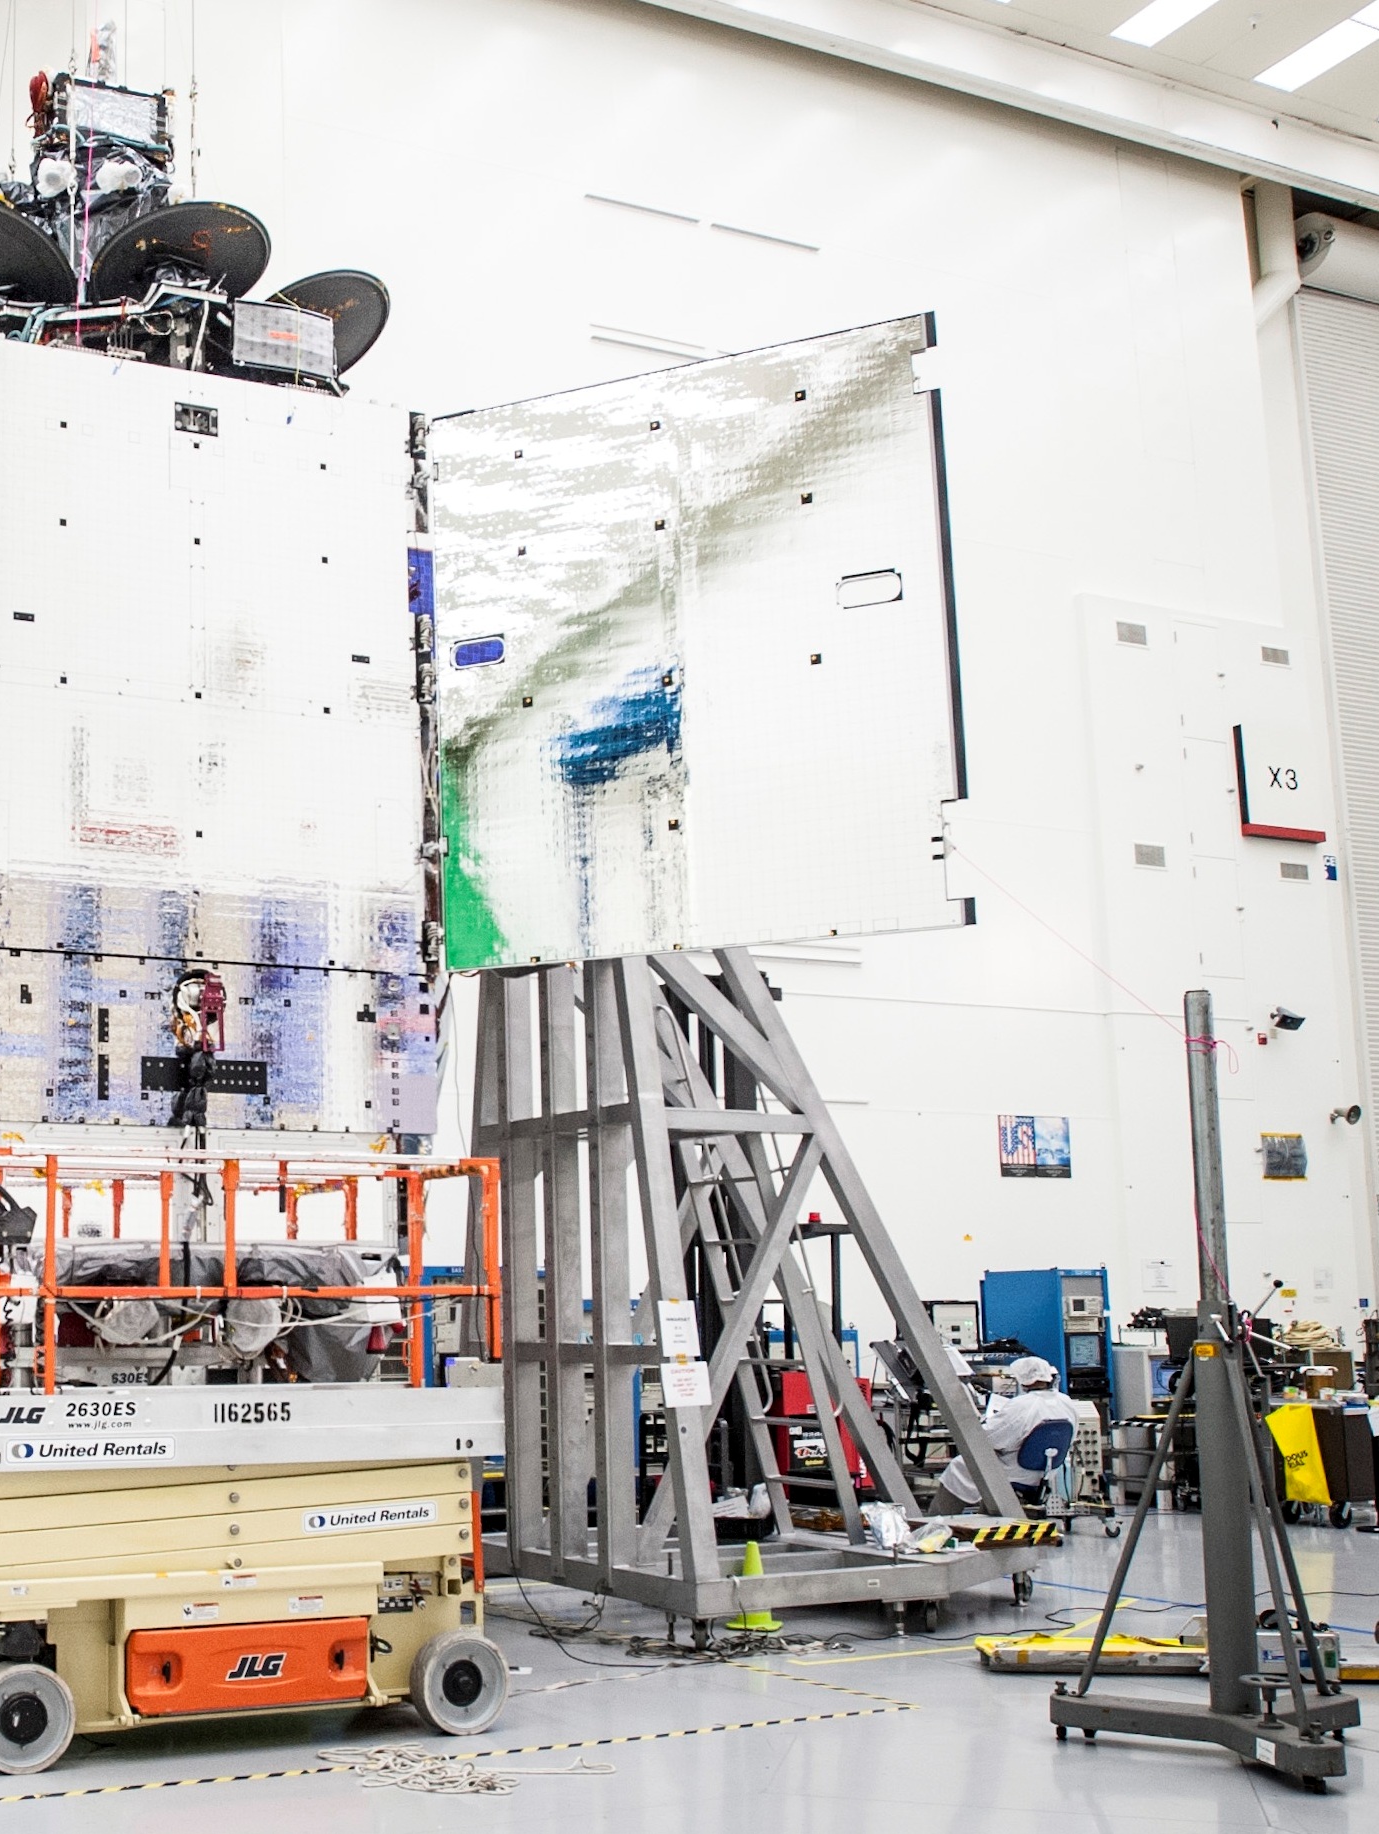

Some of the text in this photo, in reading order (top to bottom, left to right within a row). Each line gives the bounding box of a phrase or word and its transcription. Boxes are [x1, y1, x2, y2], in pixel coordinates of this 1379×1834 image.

[1268, 766, 1298, 790] X3
[0, 1407, 46, 1424] JLG
[65, 1402, 137, 1417] 2630ES
[214, 1402, 291, 1424] 1162565
[68, 1420, 132, 1430] www.jlg.com
[39, 1441, 167, 1457] United Rentals
[330, 1507, 430, 1526] United Rentals
[227, 1653, 285, 1680] JLG
